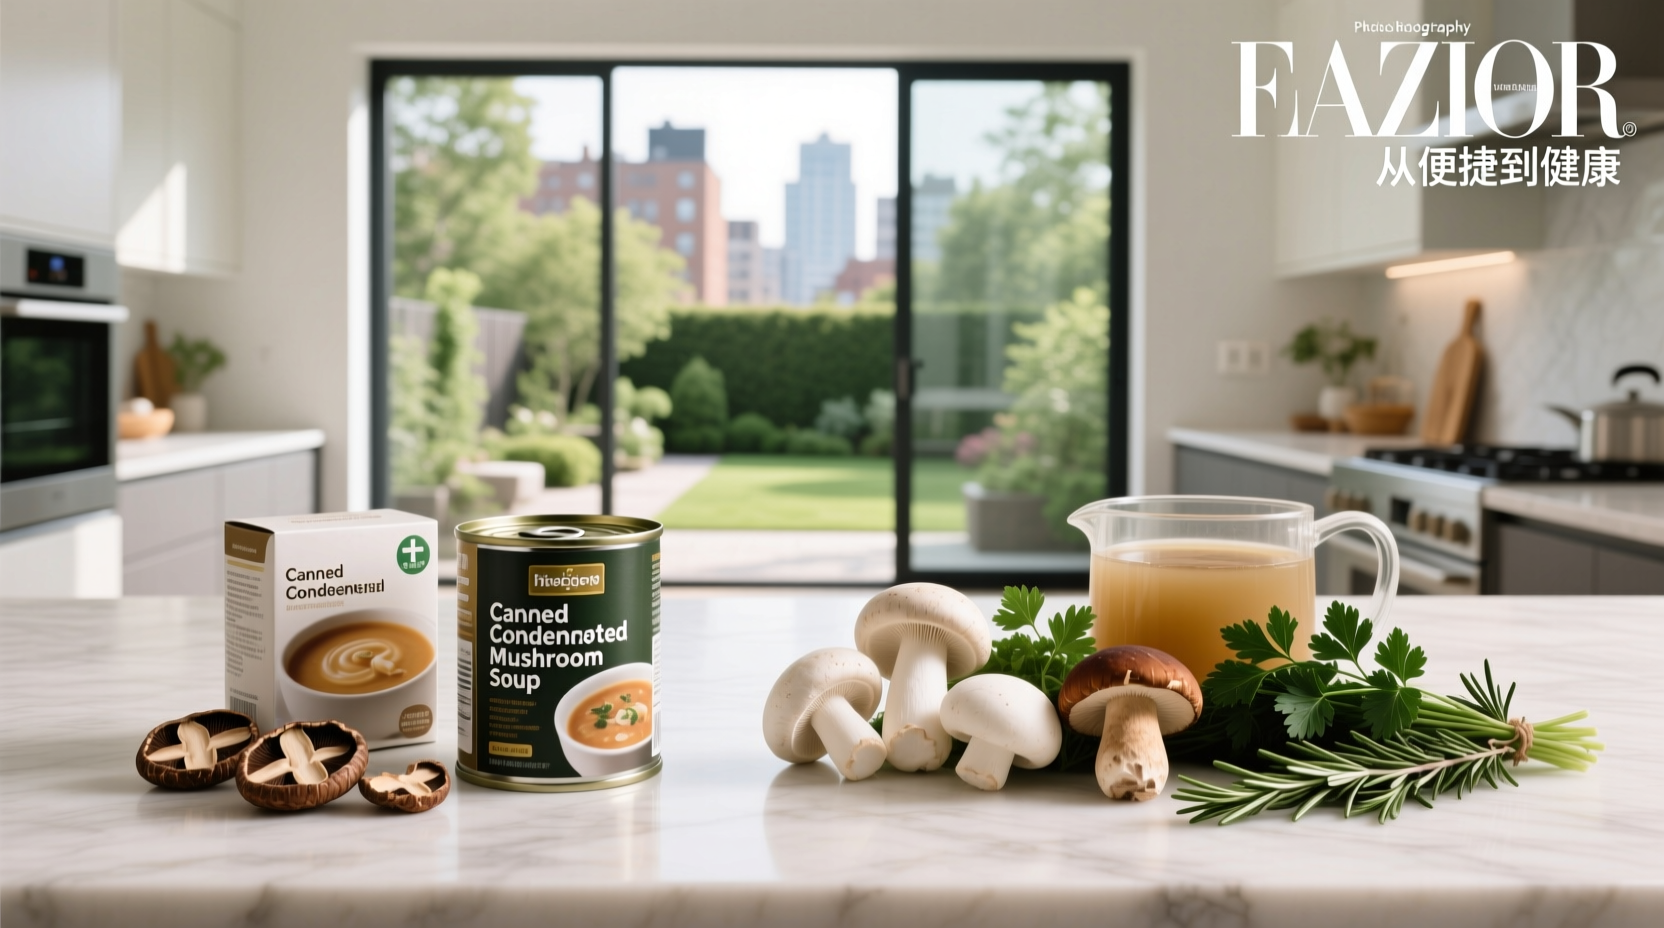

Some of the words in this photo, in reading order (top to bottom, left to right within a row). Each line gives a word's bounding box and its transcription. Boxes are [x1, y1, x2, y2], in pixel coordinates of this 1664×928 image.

[285, 564, 343, 582] Canned
[489, 602, 569, 623] Canned
[489, 646, 604, 668] Mushroom
[489, 667, 541, 695] Soup
